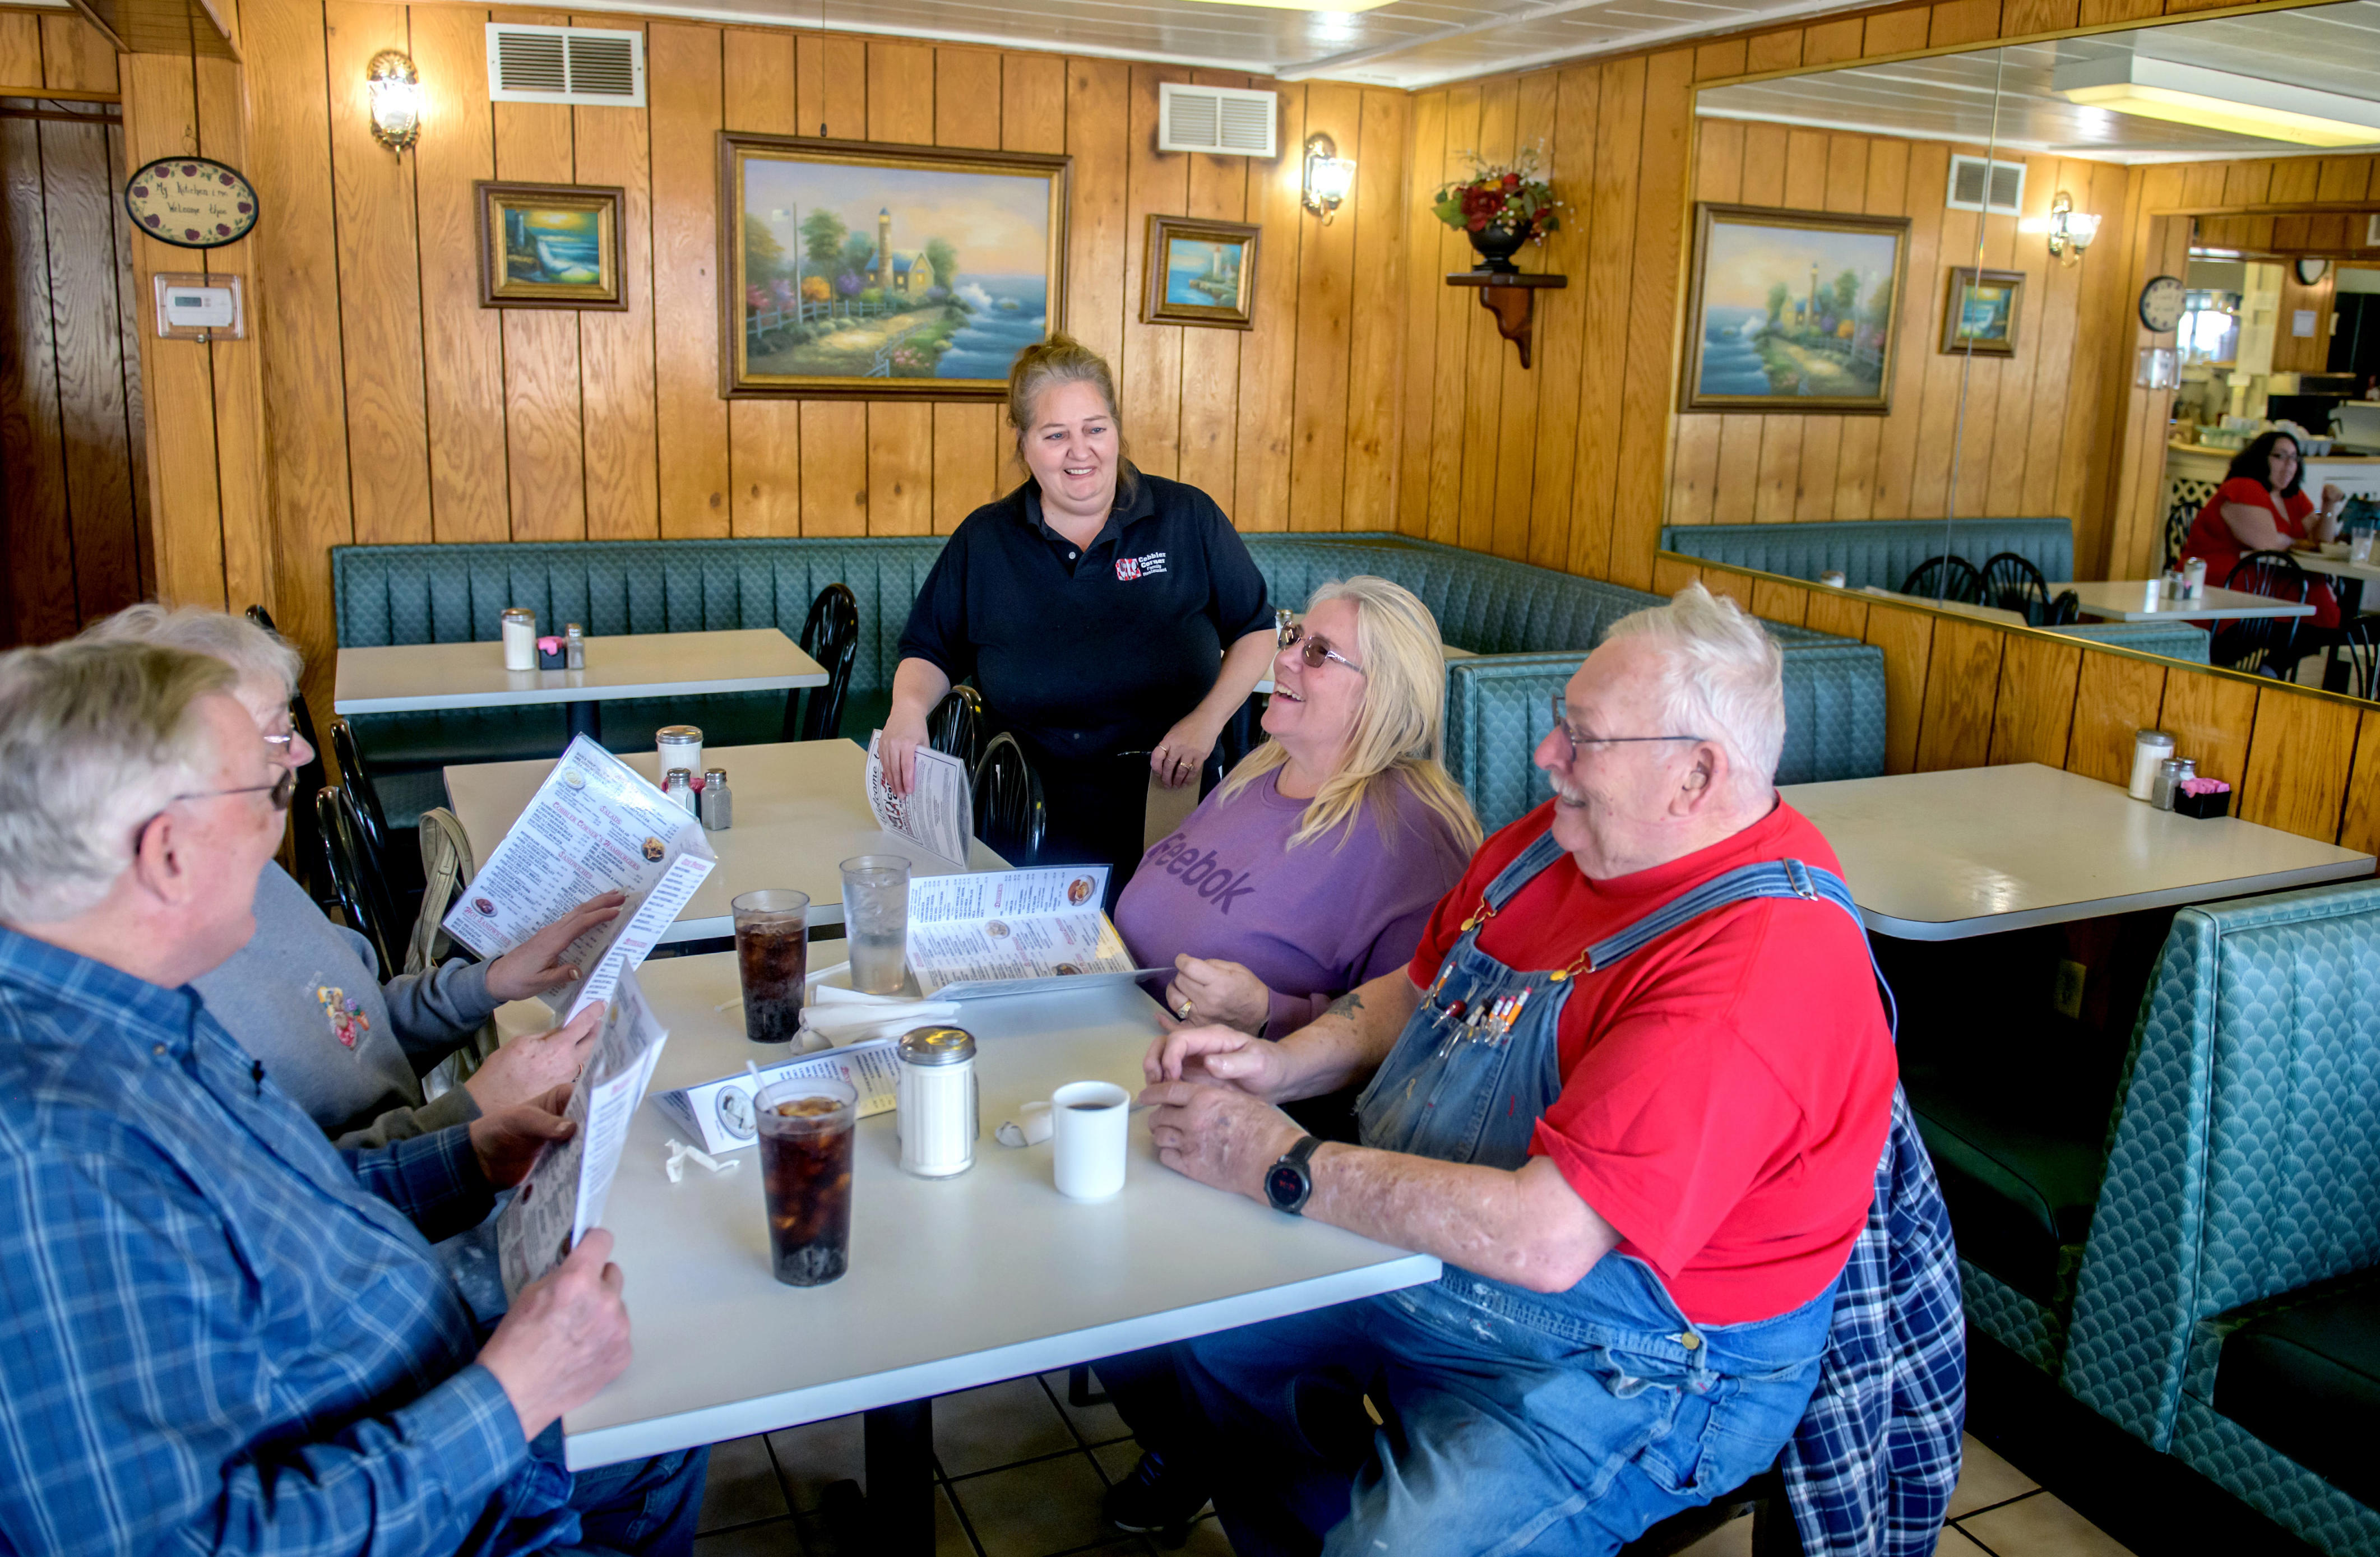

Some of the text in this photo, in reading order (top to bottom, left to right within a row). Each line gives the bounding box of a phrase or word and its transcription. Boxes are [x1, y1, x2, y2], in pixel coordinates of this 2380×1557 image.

[156, 182, 168, 198] My
[1138, 552, 1166, 563] Cobbler
[1140, 558, 1166, 568] Corner
[1142, 567, 1168, 577] Restaurant
[538, 805, 564, 826] CHEESEBURGER
[540, 801, 562, 818] HAMBURGER
[599, 805, 622, 824] SALADS
[529, 818, 549, 834] SOUTHWEST
[548, 833, 562, 845] BURGER
[535, 808, 573, 838] BACON CHEESEBURGER
[544, 821, 571, 841] CHEESEBURGER
[609, 820, 619, 828] TACO
[618, 827, 630, 837] SALAD
[552, 801, 578, 823] COBBLER
[576, 819, 604, 843] CORNER'S
[602, 838, 642, 871] HAMBURGERS
[520, 831, 540, 846] HOMEMADE
[540, 845, 561, 862] TENDERLOIN
[526, 844, 547, 860] TENDERLOIN
[601, 847, 623, 864] HAMBURGER
[507, 847, 531, 866] PIZZA BURGER
[512, 842, 555, 875] GRILLED CHICKEN BREAST
[557, 850, 594, 879] SANDWICHES
[581, 859, 595, 871] BURGER
[586, 852, 612, 873] CHEESEBURGER
[596, 854, 608, 864] BACON
[598, 851, 625, 872] CHEESEBURGER
[513, 860, 529, 873] CHICKEN
[529, 872, 542, 883] BREAST
[591, 861, 611, 878] MUSHROOM
[490, 870, 506, 883] GRILLED
[505, 882, 522, 896] AMERICAN
[494, 865, 515, 881] HOMEMADE
[521, 885, 531, 893] PORK
[572, 870, 595, 888] PHILLY STEAK
[496, 884, 513, 899] SANDWICH
[570, 883, 585, 895] CHICKEN
[994, 883, 1003, 908] DESSERTS
[552, 898, 563, 907] PATTY
[545, 907, 559, 919] REUBEN
[460, 926, 482, 943] TENDERLOIN
[463, 906, 479, 920] HOT
[476, 916, 513, 946] SANDWICHES
[463, 923, 481, 938] MEATLOAF
